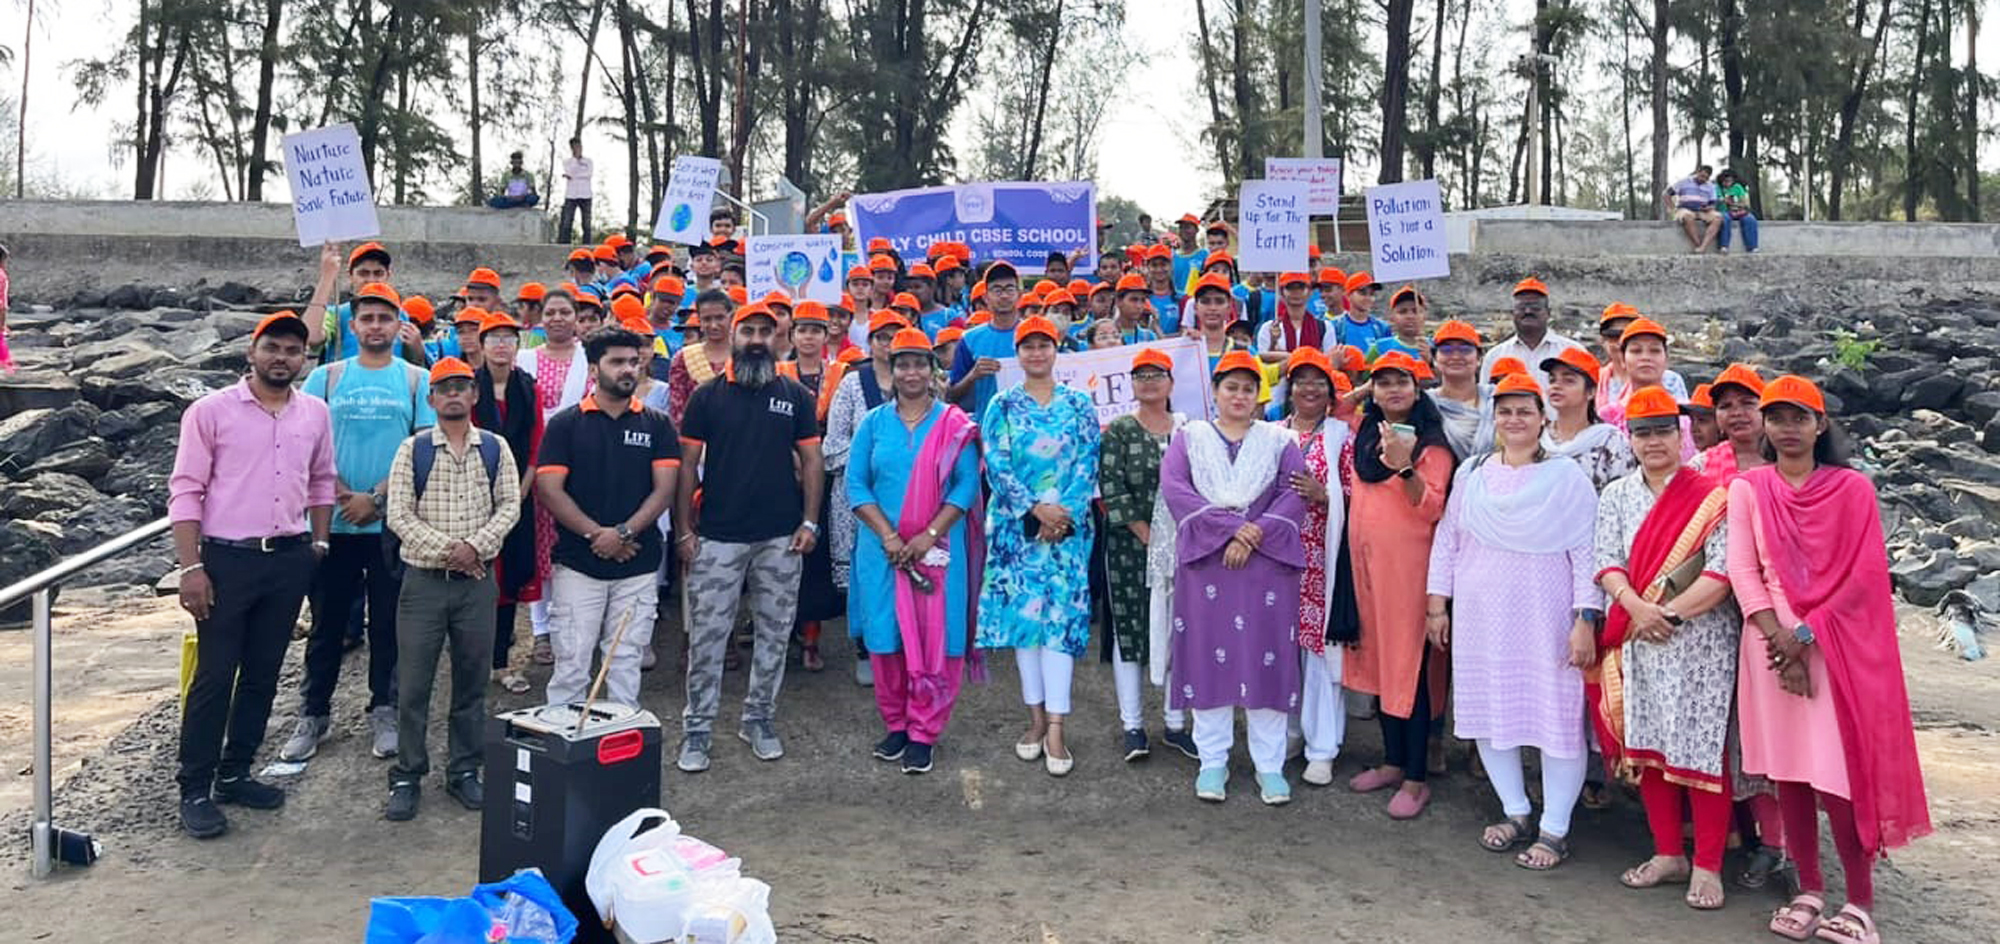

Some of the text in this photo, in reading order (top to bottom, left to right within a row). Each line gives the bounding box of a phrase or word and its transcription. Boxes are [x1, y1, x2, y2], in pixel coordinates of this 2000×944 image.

[294, 143, 350, 164] Nurture
[300, 165, 354, 188] Nature
[329, 188, 367, 206] Future
[1255, 193, 1295, 208] Stand
[1265, 210, 1280, 222] for
[1400, 220, 1419, 233] not
[1424, 219, 1433, 230] a
[916, 230, 966, 248] CHILD
[971, 228, 1013, 243] CBSE
[1018, 228, 1087, 243] SCHOOL
[1256, 228, 1295, 250] Earth
